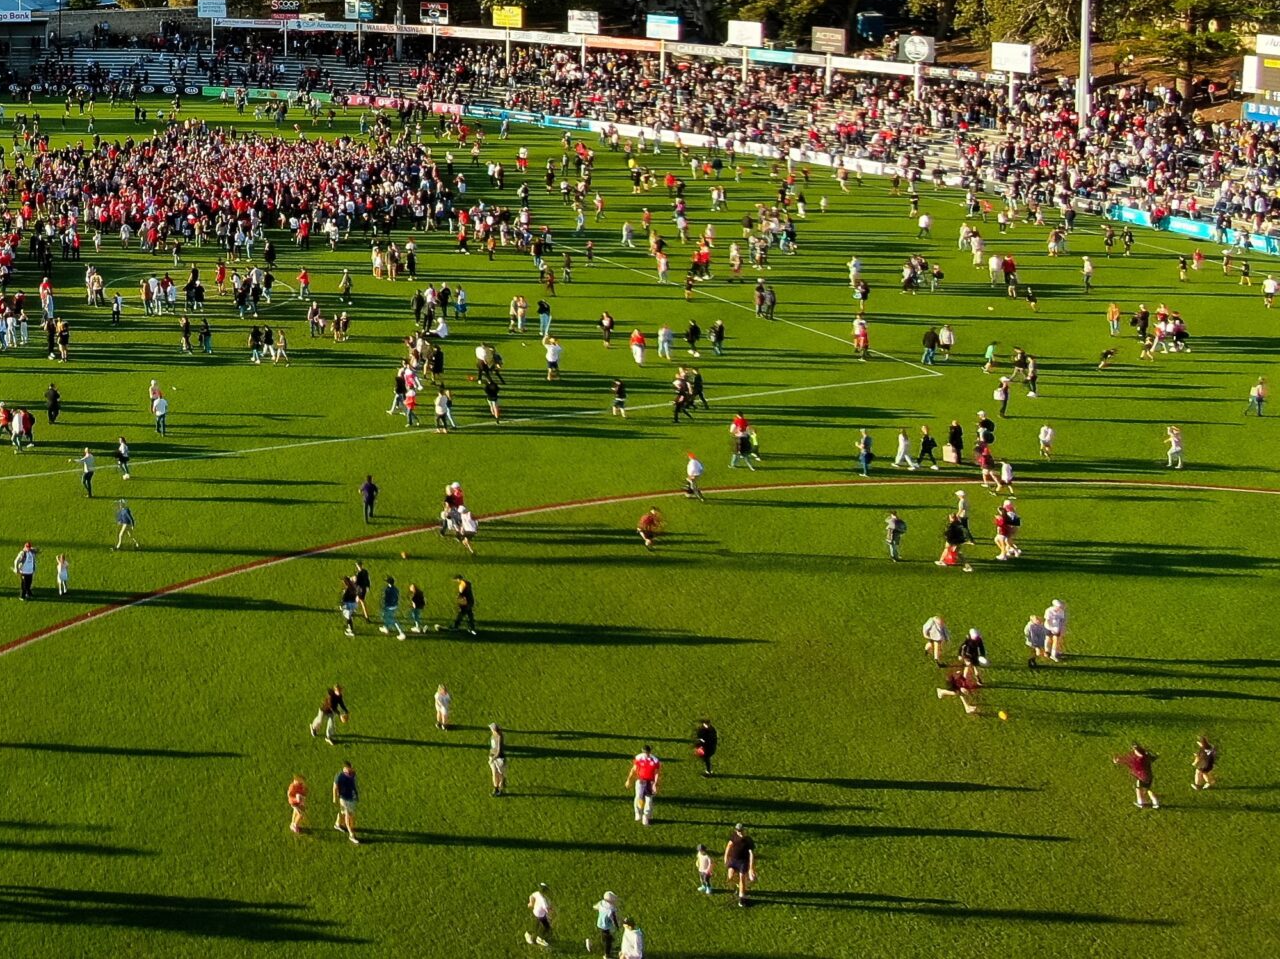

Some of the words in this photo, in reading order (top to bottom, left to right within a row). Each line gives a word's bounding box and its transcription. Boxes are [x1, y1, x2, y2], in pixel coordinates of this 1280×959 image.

[271, 0, 300, 10] SCOOP
[9, 12, 30, 20] Bank
[317, 21, 347, 30] Accounting
[1247, 103, 1279, 116] BEN
